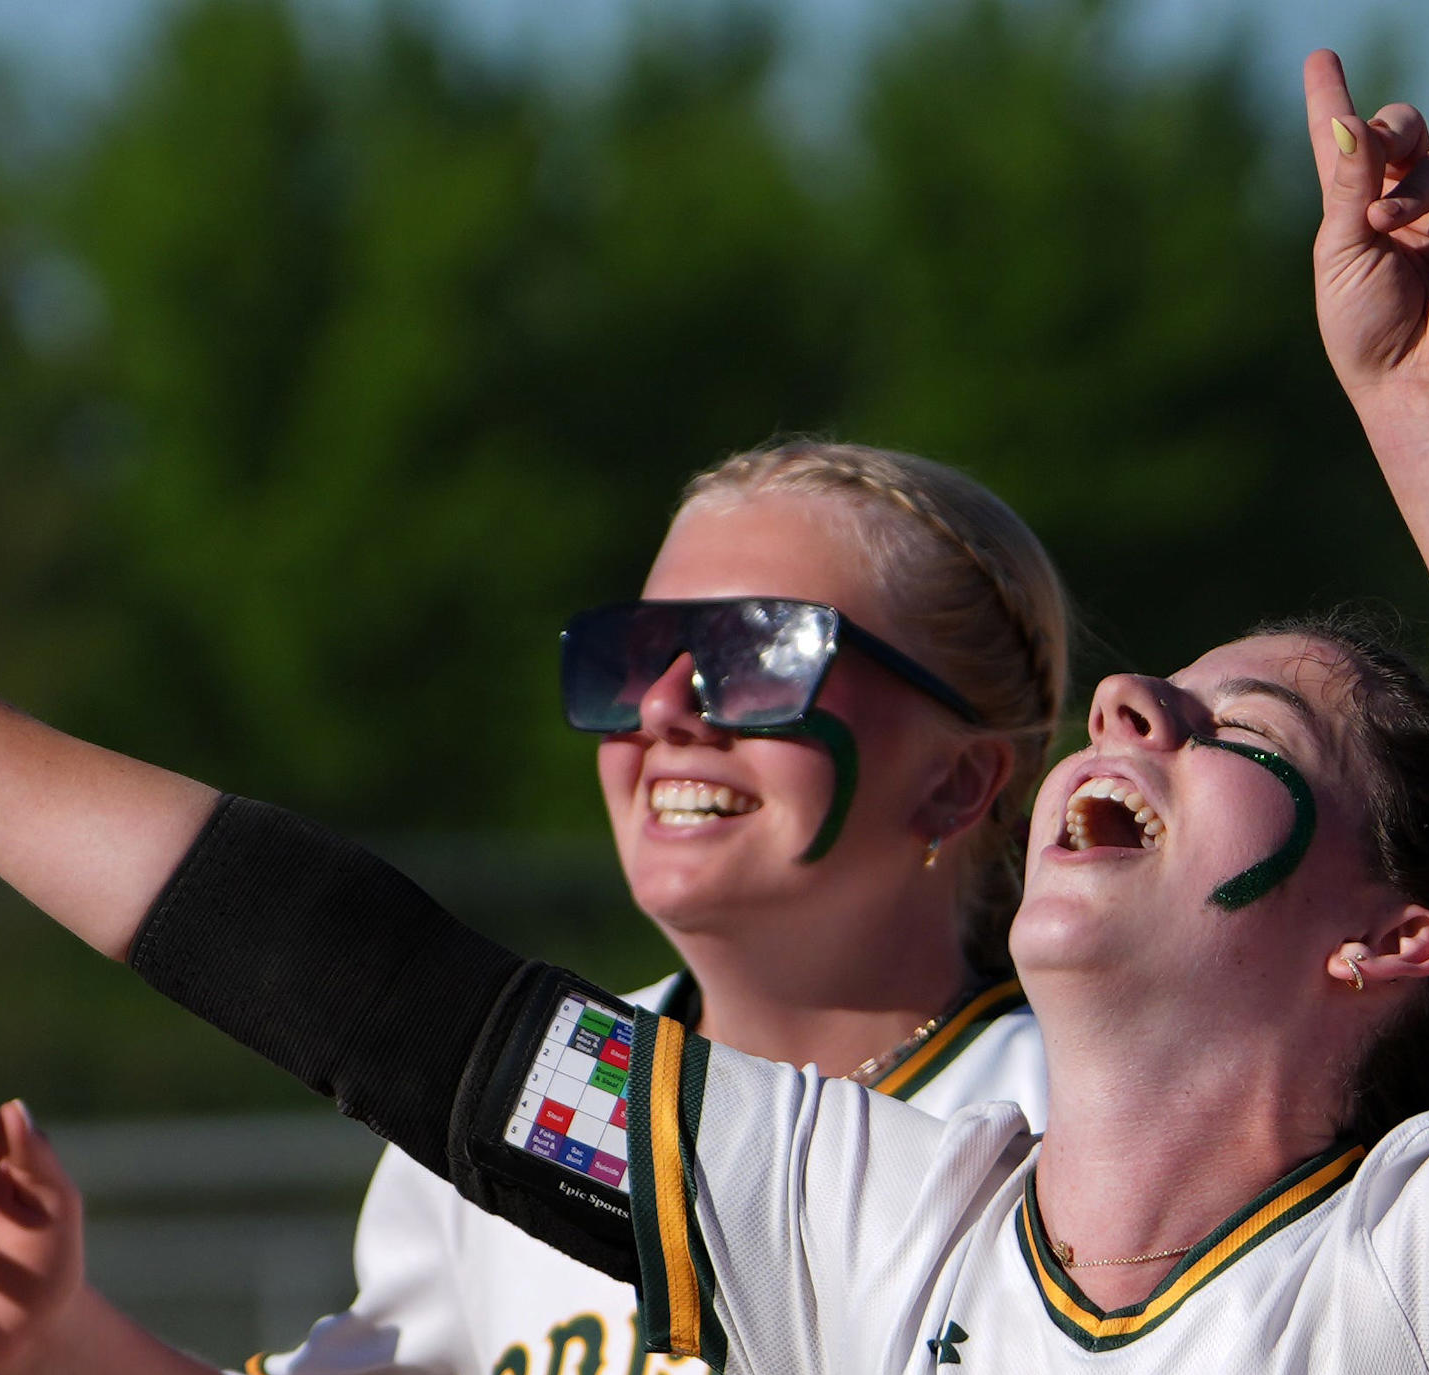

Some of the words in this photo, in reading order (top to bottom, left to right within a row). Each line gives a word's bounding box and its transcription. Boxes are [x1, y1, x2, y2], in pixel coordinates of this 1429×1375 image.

[542, 1048, 550, 1057] 2
[532, 1073, 539, 1082] 3
[521, 1100, 528, 1108] 4
[546, 1110, 564, 1123] Steal
[510, 1126, 518, 1134] 5
[539, 1127, 556, 1141] Fake
[594, 1161, 620, 1176] Suicide
[559, 1181, 587, 1200] Epic
[588, 1193, 630, 1219] Sports
